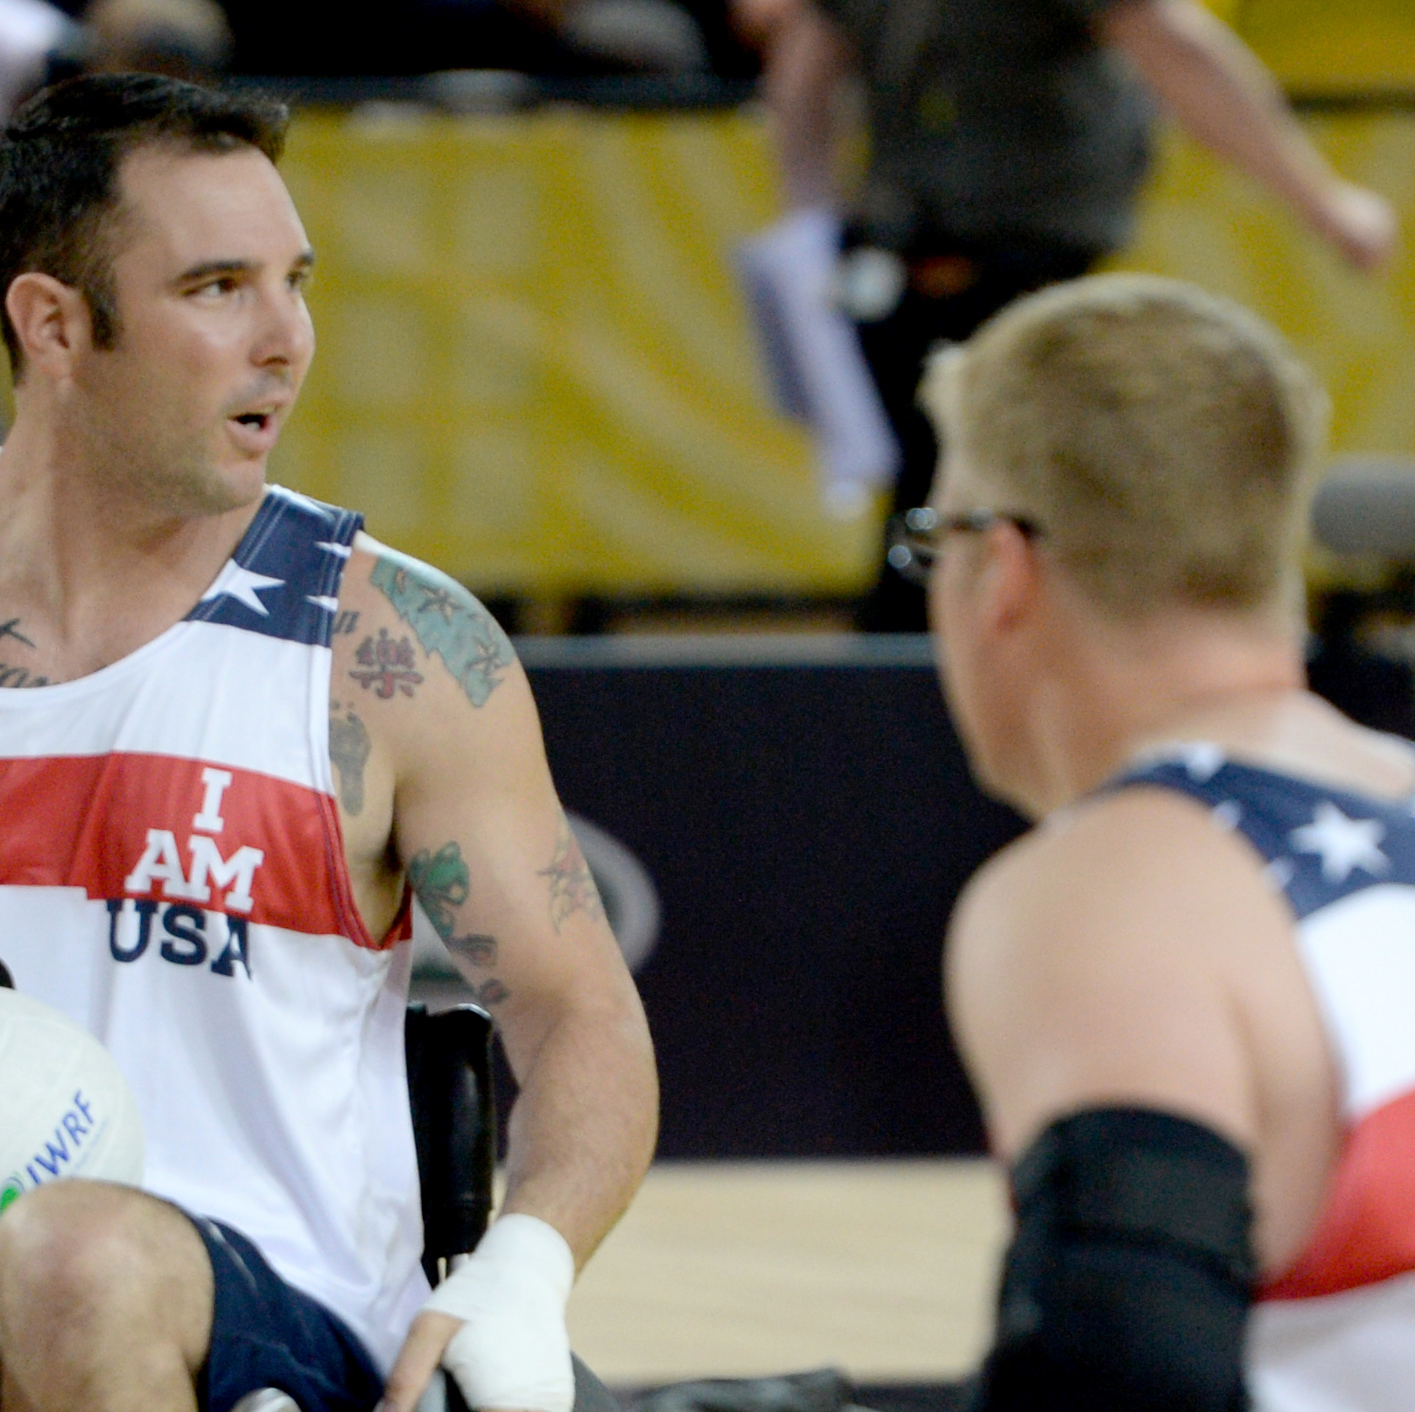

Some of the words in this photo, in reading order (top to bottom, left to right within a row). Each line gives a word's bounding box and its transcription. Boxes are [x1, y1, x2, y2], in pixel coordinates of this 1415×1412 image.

[193, 767, 233, 833] I
[125, 828, 264, 913] AM
[106, 898, 252, 980] USA
[26, 1089, 93, 1185] IWRF
